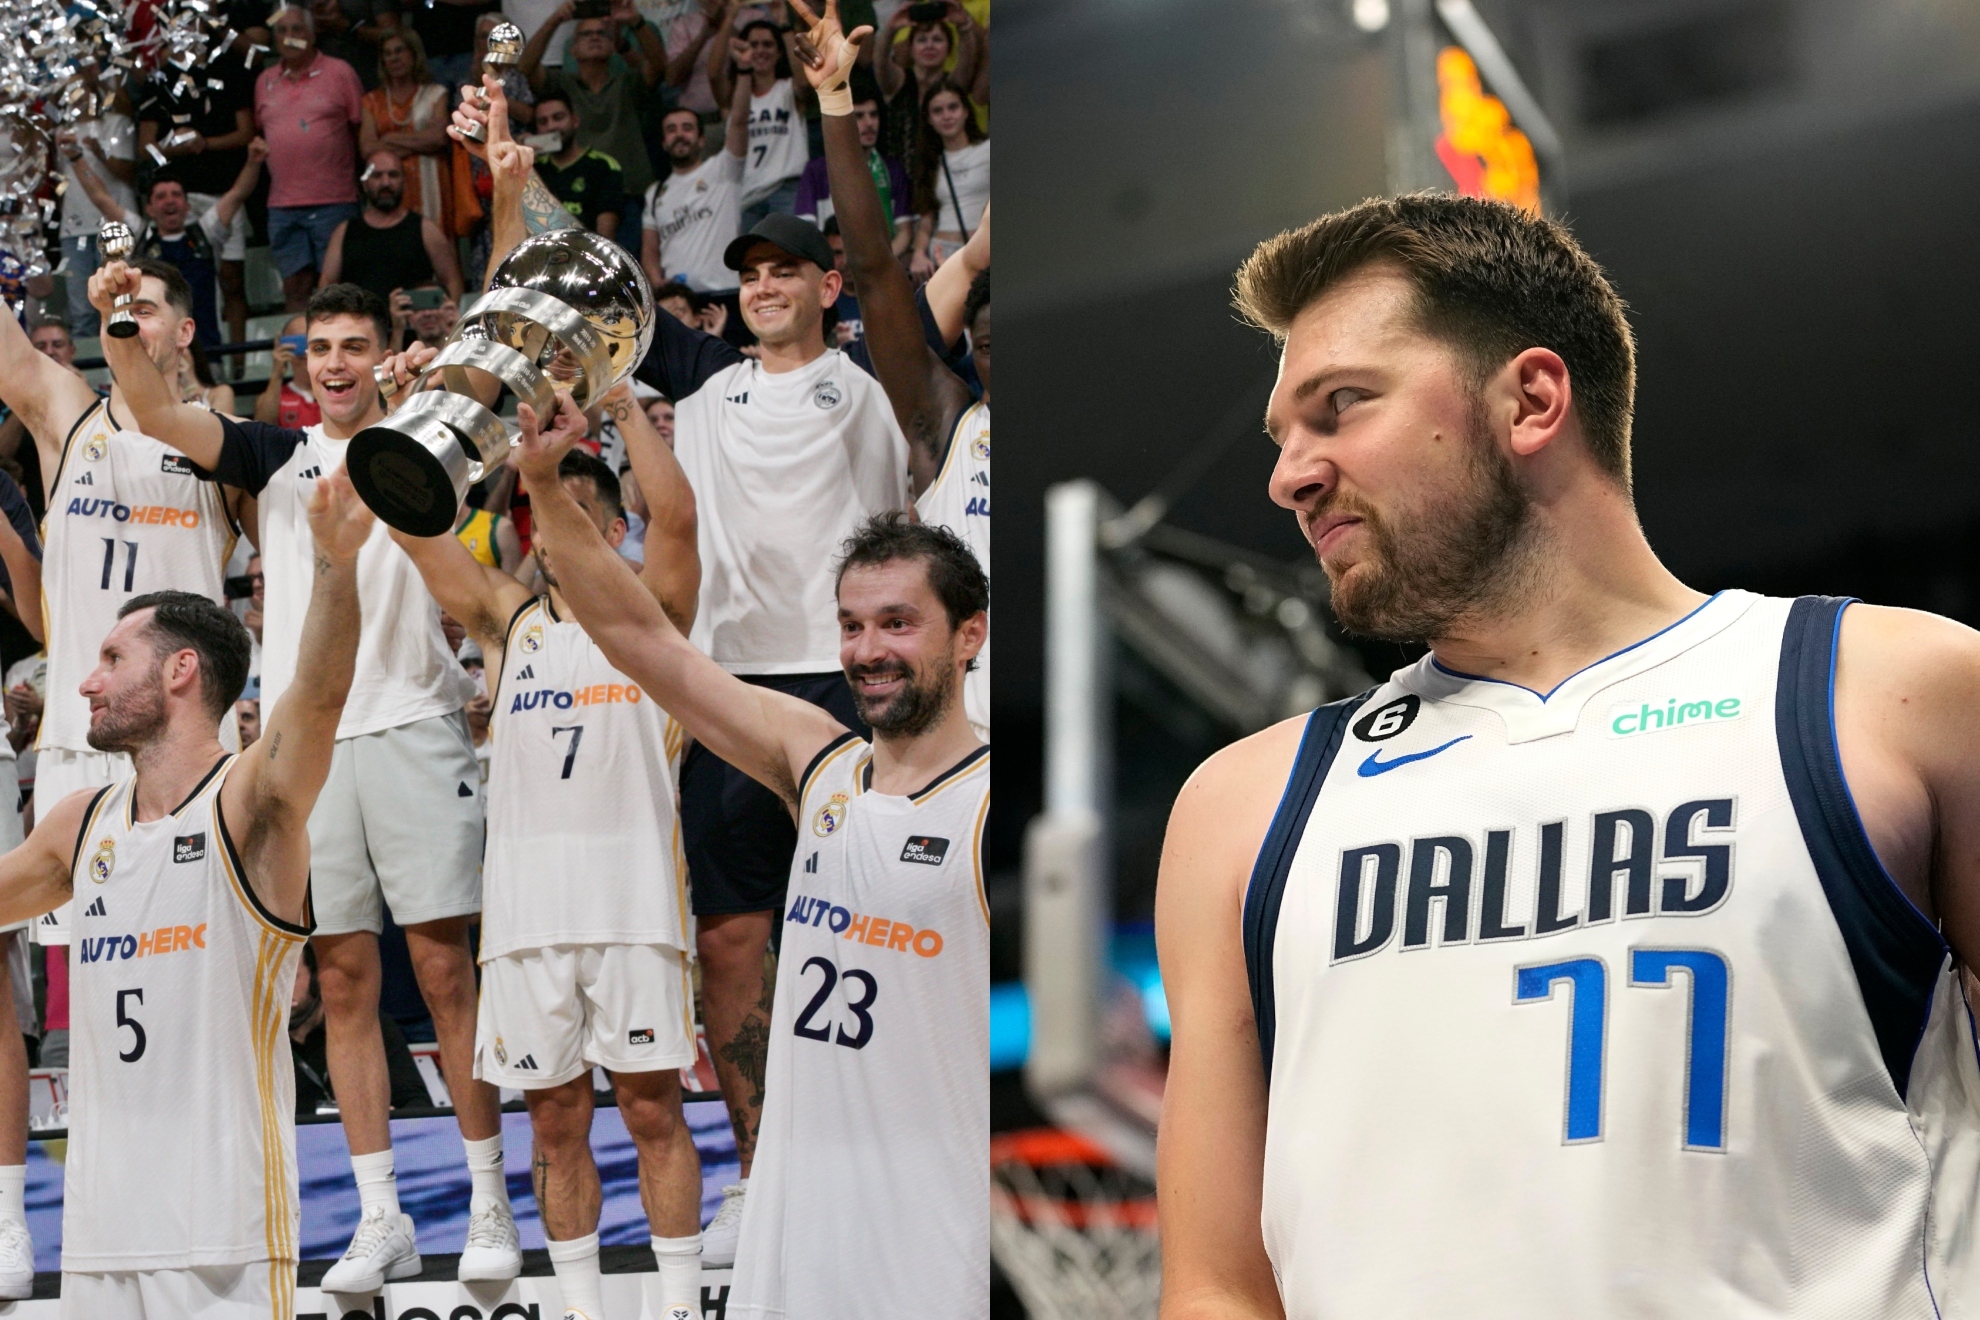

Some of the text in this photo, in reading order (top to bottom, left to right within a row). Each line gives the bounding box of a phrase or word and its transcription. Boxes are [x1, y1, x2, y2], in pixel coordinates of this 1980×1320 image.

[753, 145, 767, 168] 7
[67, 498, 199, 529] AUTOHERO
[100, 537, 138, 592] 11
[510, 684, 642, 714] AUTOHERO
[1368, 703, 1408, 737] 6
[1612, 698, 1741, 735] chime
[552, 725, 584, 780] 7
[176, 849, 204, 861] endesa
[177, 844, 192, 854] liga
[903, 852, 942, 863] endesa
[907, 842, 925, 853] liga
[1329, 795, 1738, 967] DALLAS
[786, 895, 944, 959] AUTOHERO
[794, 956, 878, 1050] 23
[116, 988, 147, 1063] 5
[631, 1034, 650, 1043] acb
[1511, 944, 1734, 1154] 77
